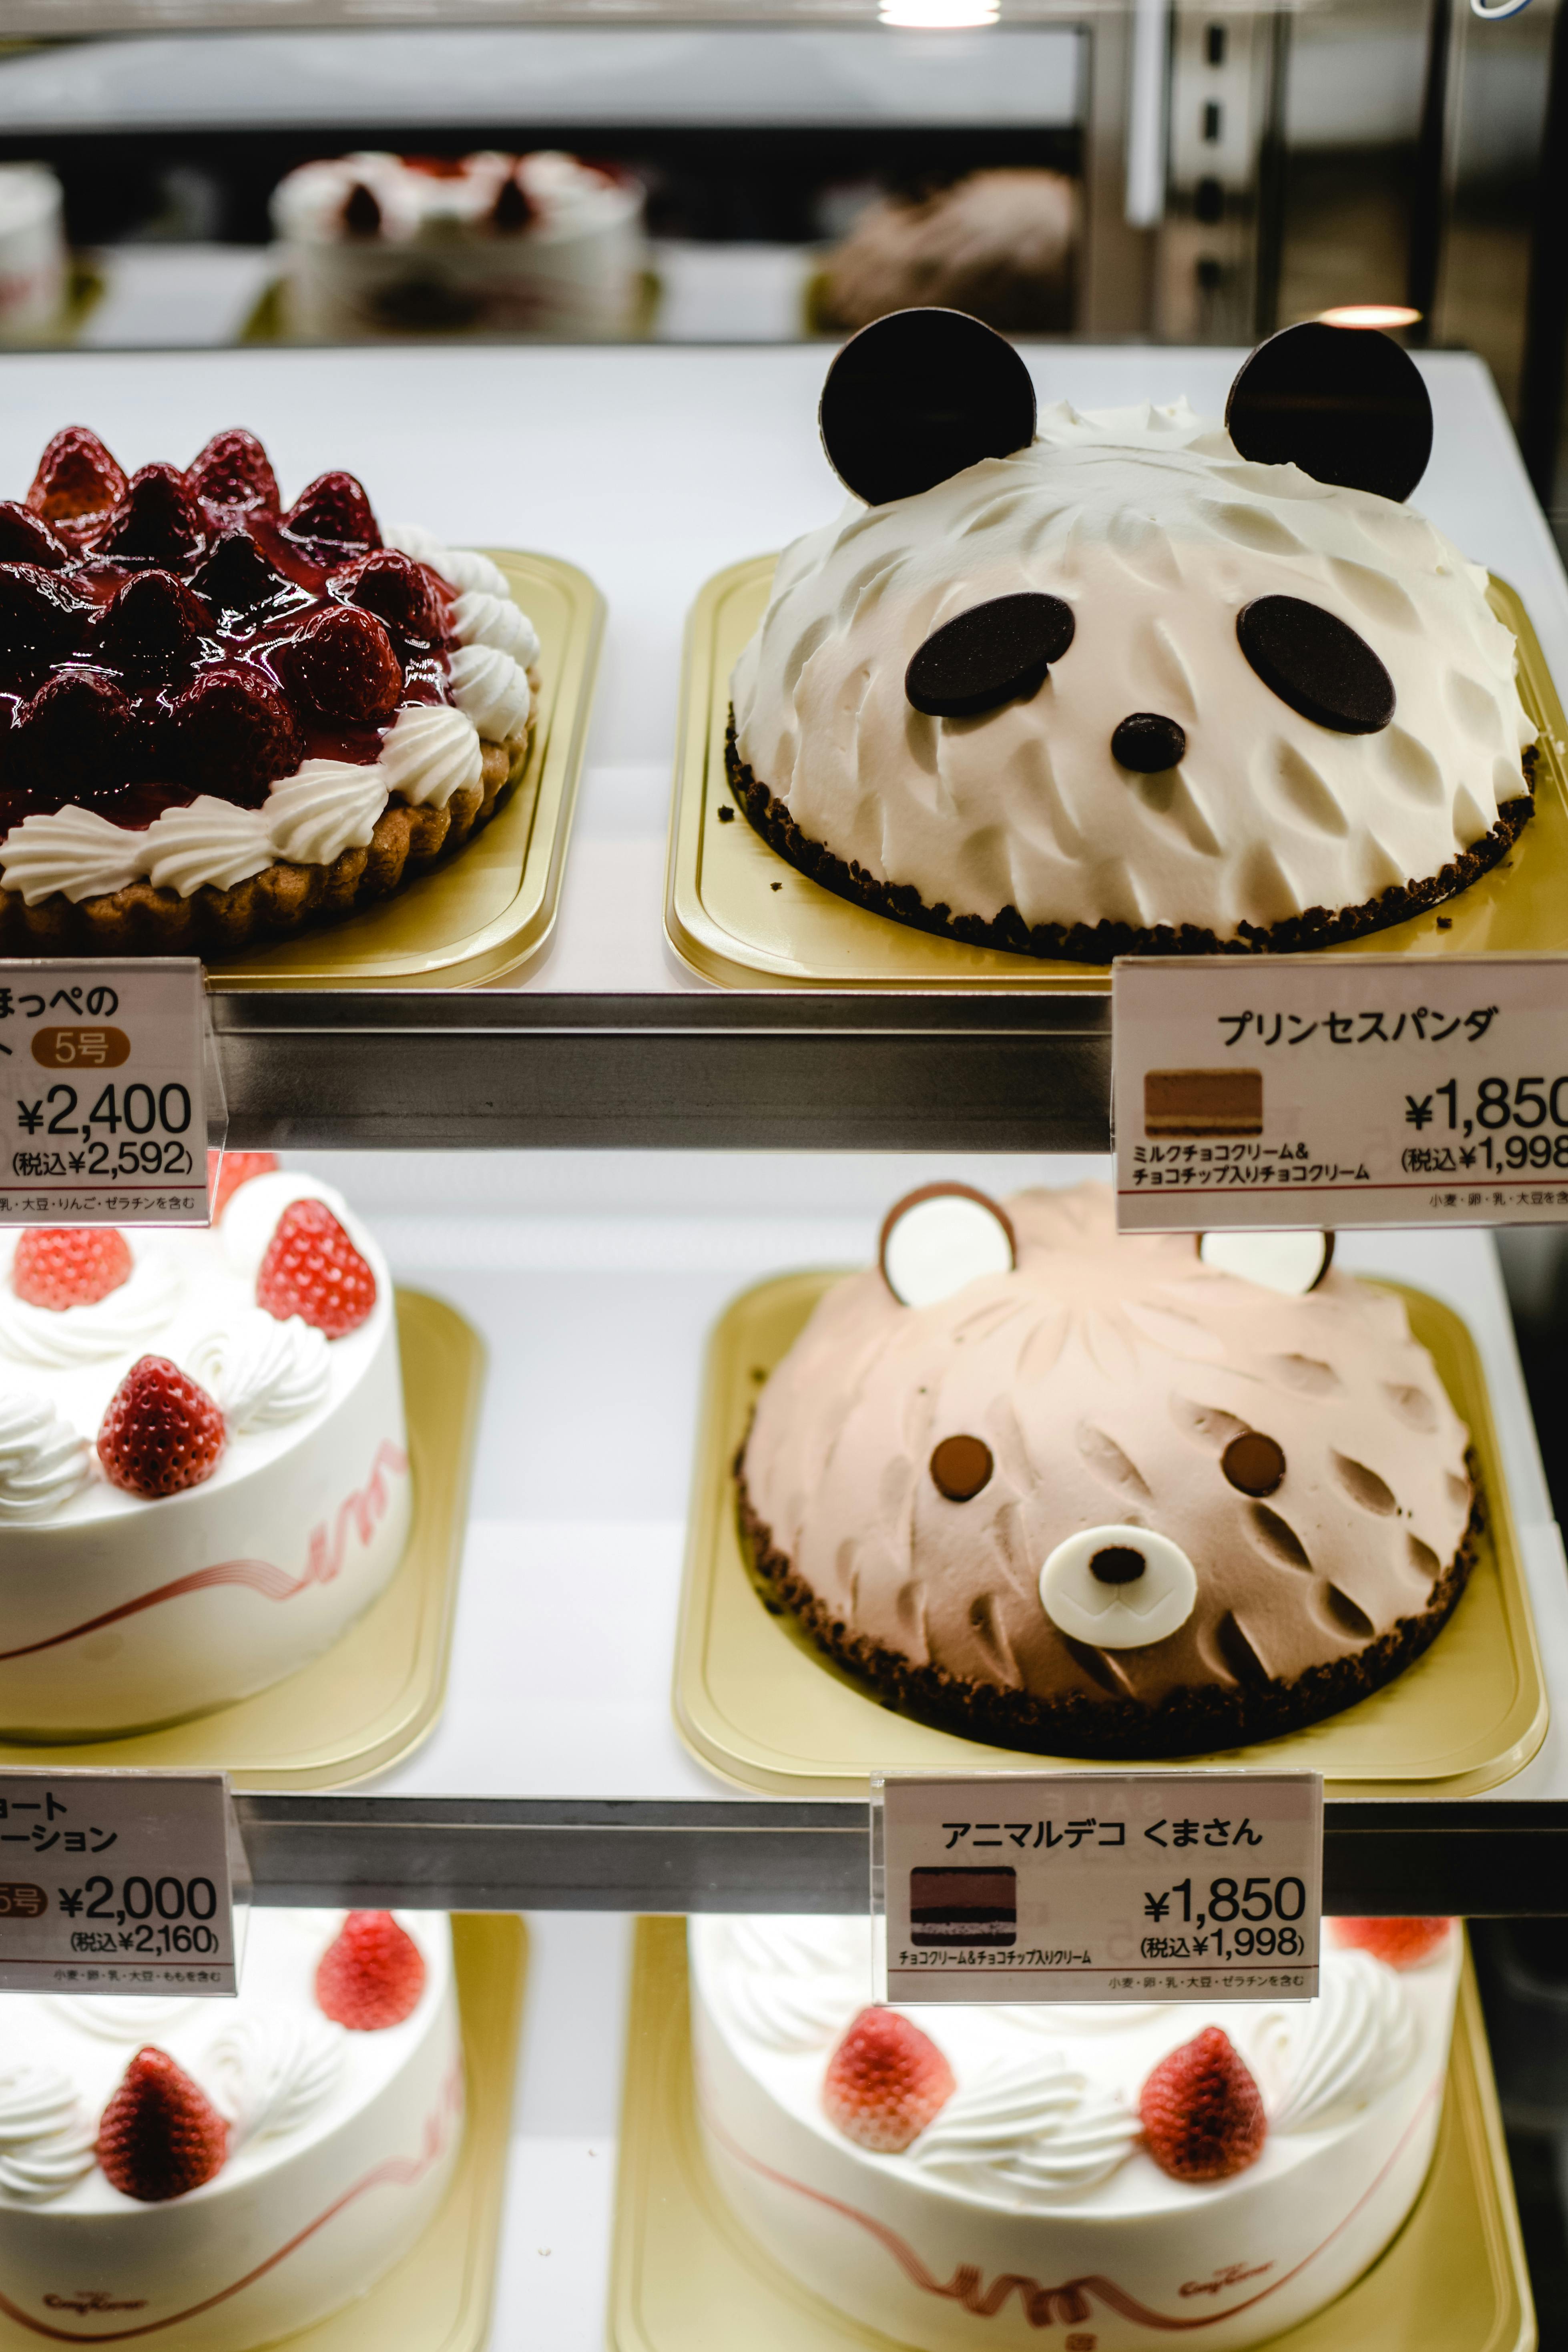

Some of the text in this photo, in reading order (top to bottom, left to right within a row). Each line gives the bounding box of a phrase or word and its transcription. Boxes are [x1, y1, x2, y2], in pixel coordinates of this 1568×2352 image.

[1219, 1005, 1499, 1046] プリンセスパンダ
[56, 1032, 108, 1064] 5号
[17, 1083, 191, 1142] ¥2,400
[12, 1141, 193, 1180] (税込¥2,592)
[1133, 1142, 1308, 1162] ミルクチョコクリーム&
[1133, 1164, 1370, 1186] チョコチップ入りチョコクリーム
[942, 1818, 1263, 1849] アニマルデコ くまさん
[58, 1875, 217, 1926] ¥2,000
[1144, 1877, 1306, 1930] ¥1,850
[71, 1925, 219, 1956] (税込¥2,160)
[1141, 1927, 1305, 1961] (税込¥1,998)
[899, 1950, 1091, 1965] チョコクリーム&チョコチップ入りクリーム
